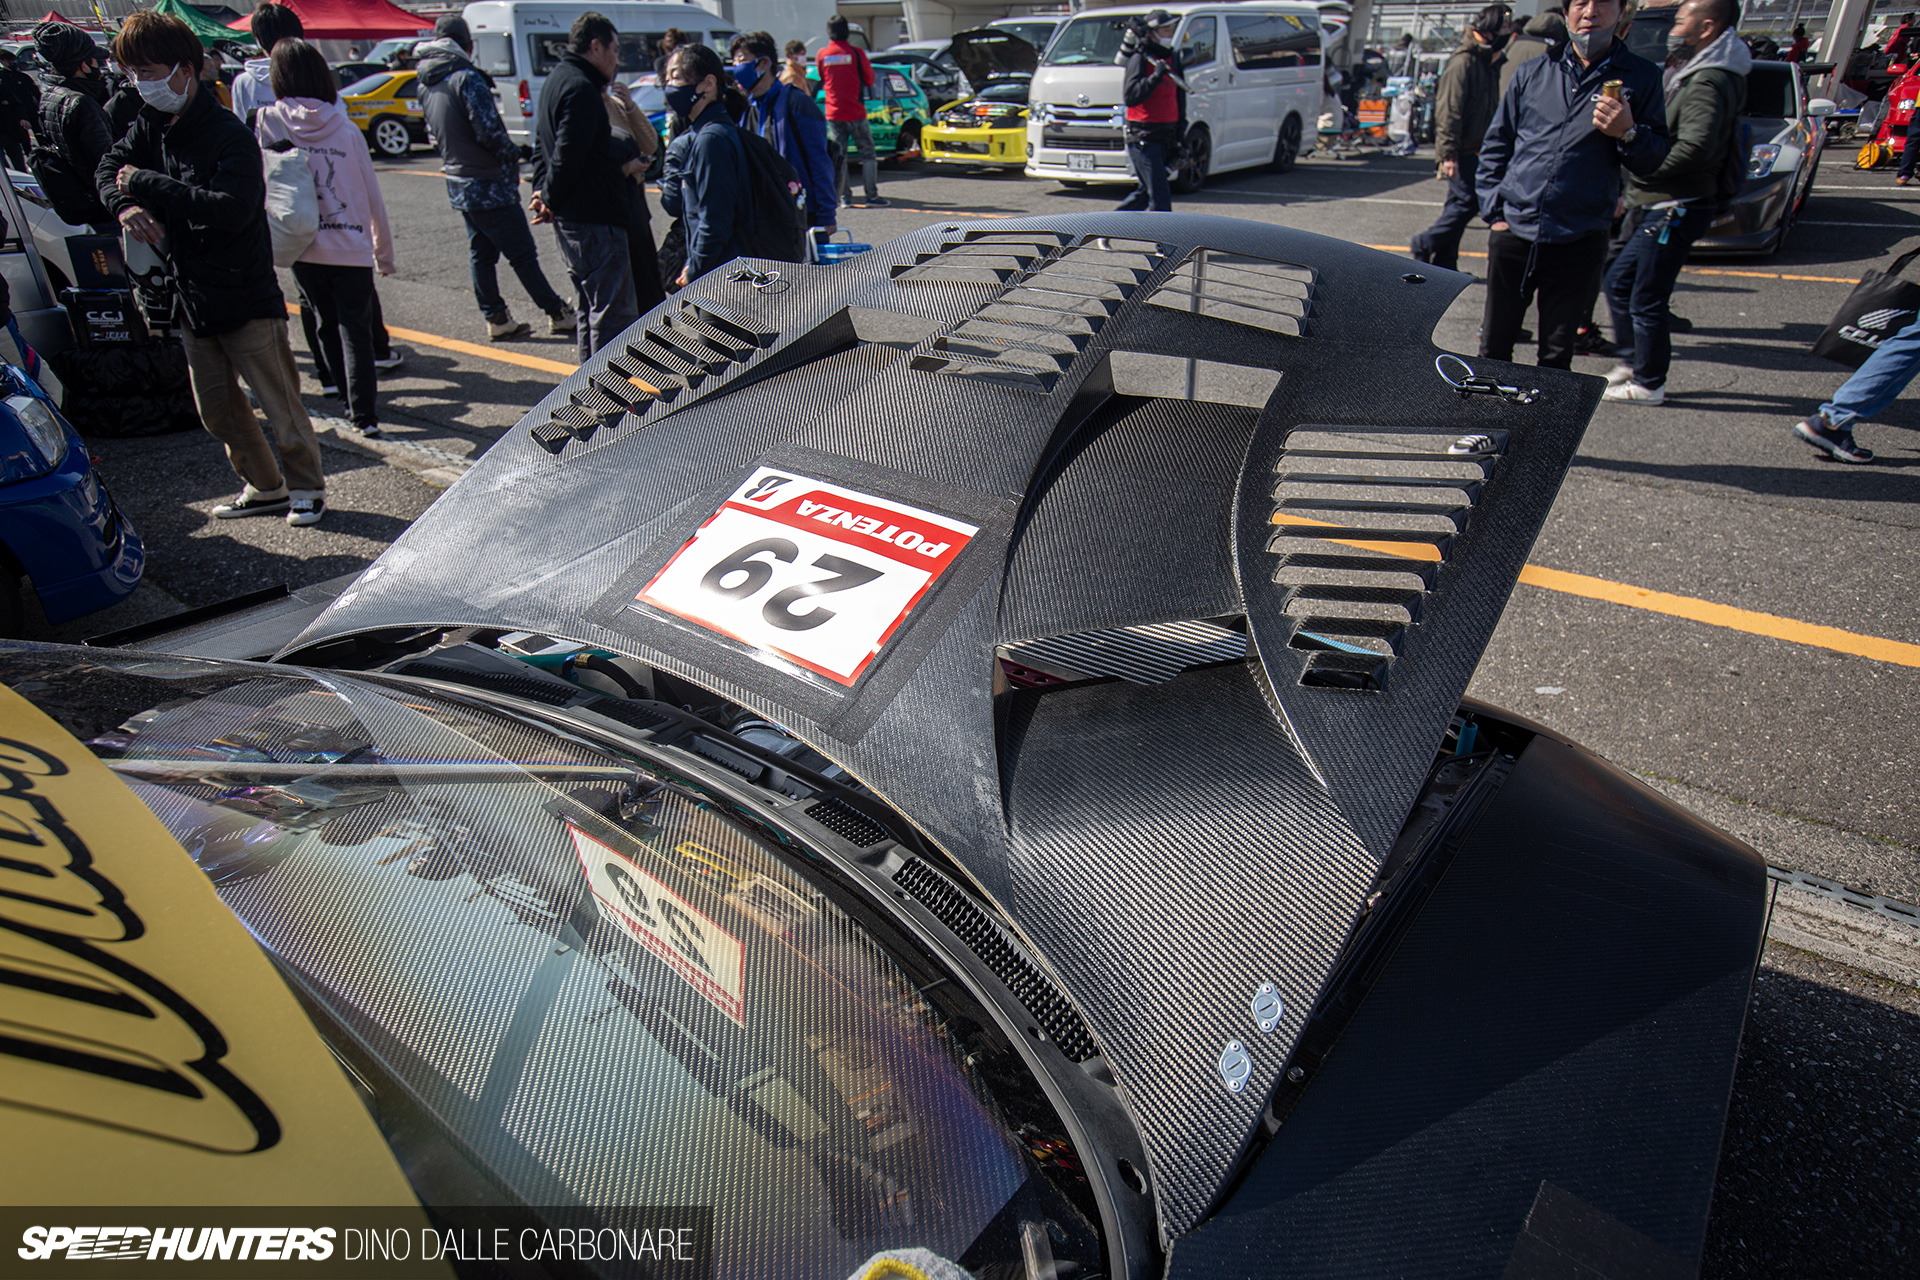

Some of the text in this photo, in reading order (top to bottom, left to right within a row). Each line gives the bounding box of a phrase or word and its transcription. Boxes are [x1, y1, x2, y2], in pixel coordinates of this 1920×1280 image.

[308, 146, 328, 154] Parts
[329, 147, 347, 158] Shop
[318, 221, 363, 233] ineering
[795, 499, 951, 559] POTENZA
[699, 537, 885, 632] 29
